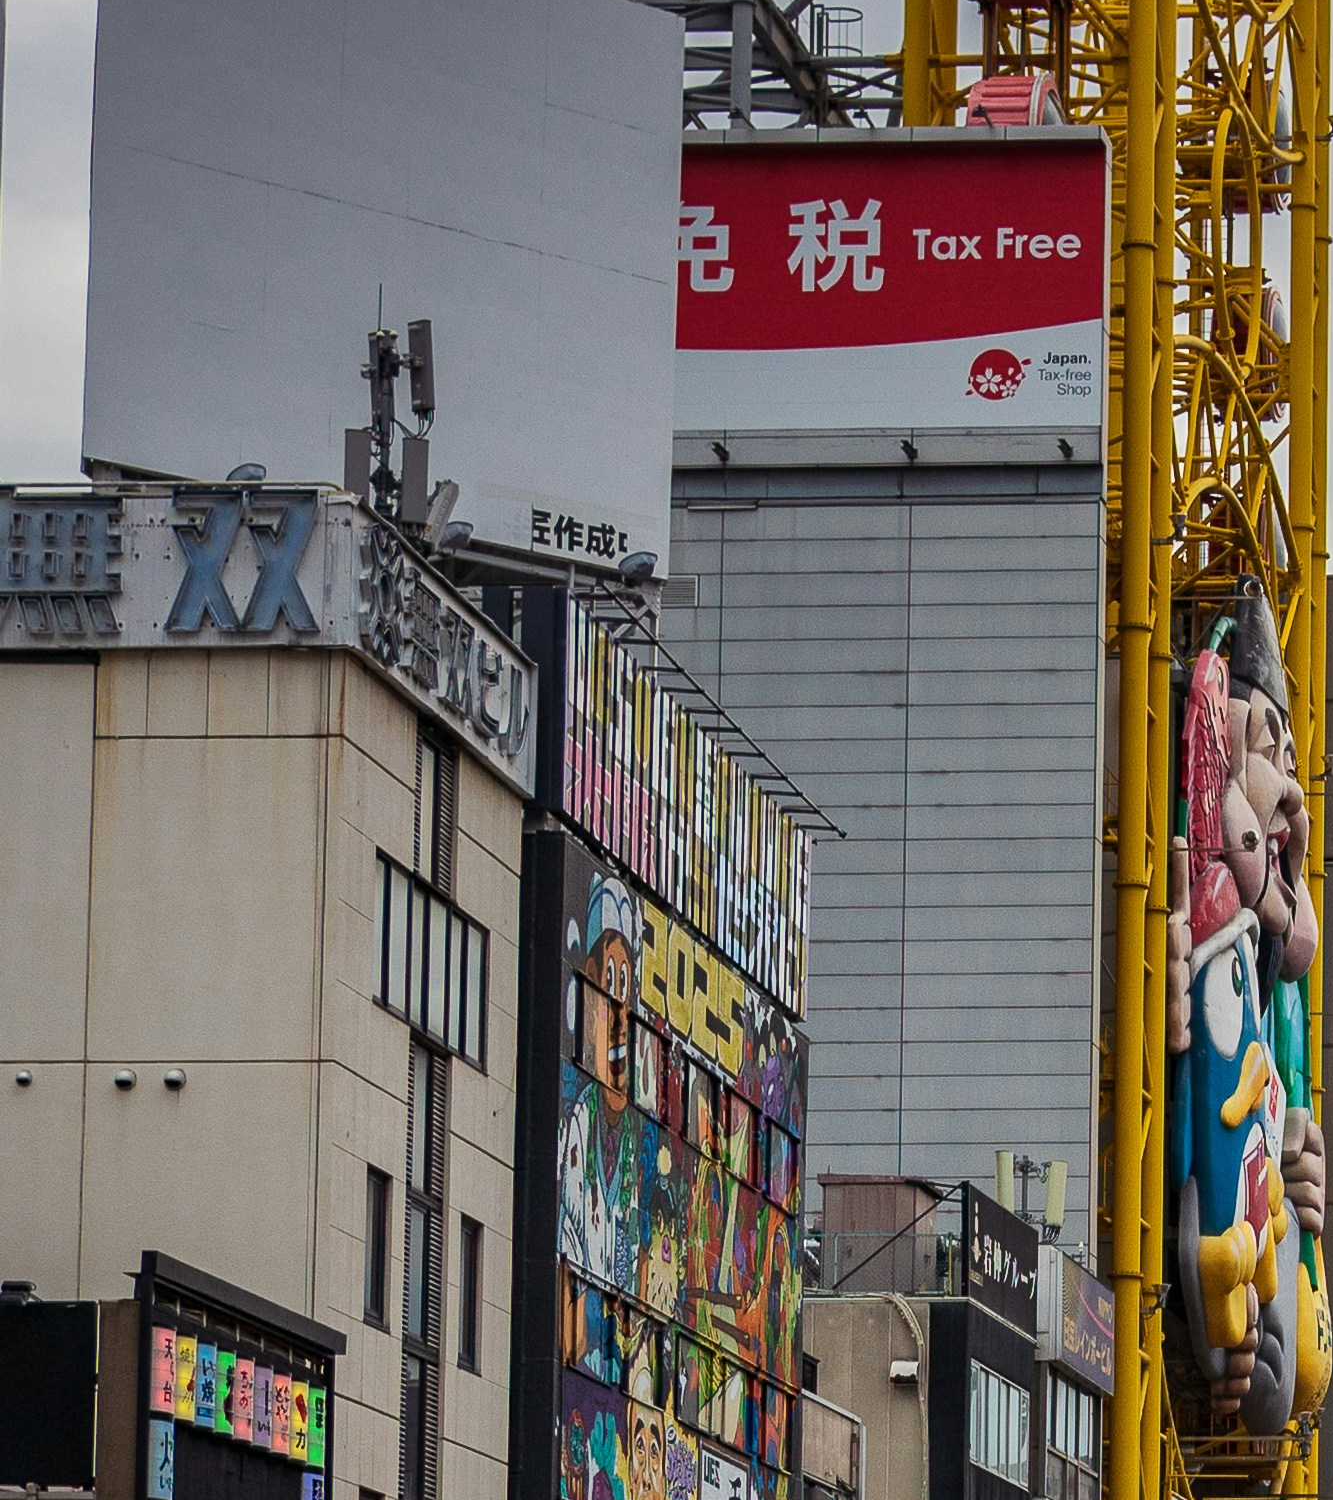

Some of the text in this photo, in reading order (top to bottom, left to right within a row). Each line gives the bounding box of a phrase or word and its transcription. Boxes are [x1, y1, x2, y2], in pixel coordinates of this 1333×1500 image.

[912, 227, 1082, 260] Tax Free
[1042, 351, 1092, 366] Japan.
[1038, 368, 1092, 382] Tax-free
[1056, 383, 1092, 398] Shop
[639, 897, 747, 1084] 2025
